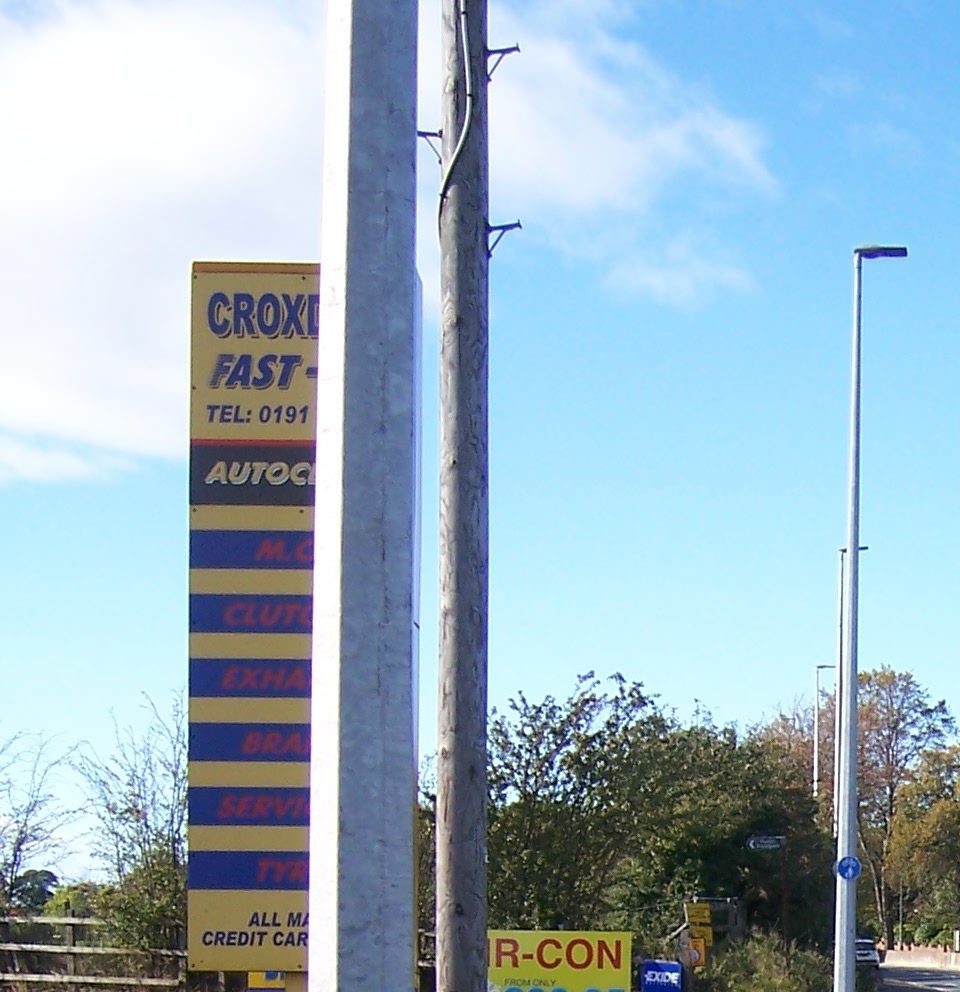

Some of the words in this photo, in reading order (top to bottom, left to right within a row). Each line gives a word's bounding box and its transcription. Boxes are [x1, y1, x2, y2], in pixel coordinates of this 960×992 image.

[206, 405, 252, 423] TEL:
[259, 405, 309, 423] 0191
[241, 731, 311, 754] BRA
[216, 794, 310, 818] SERVI
[248, 912, 281, 927] ALL
[202, 931, 265, 947] CREDIT
